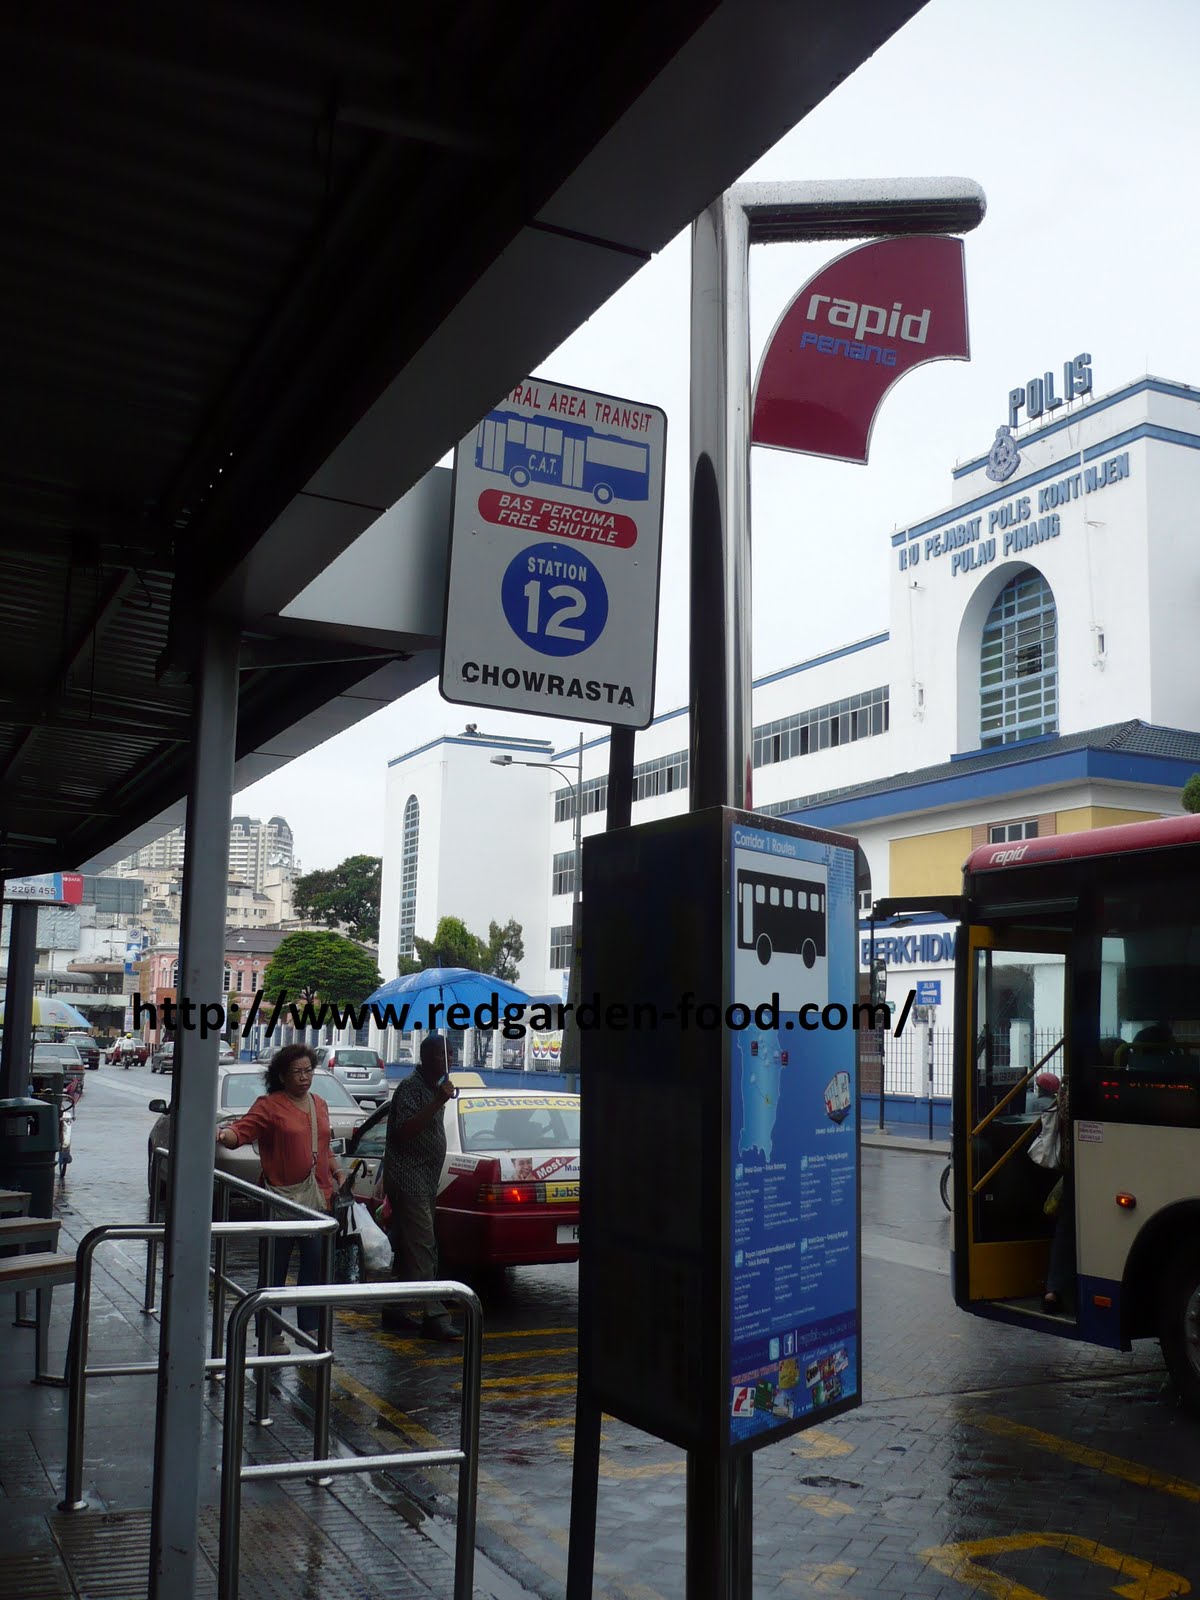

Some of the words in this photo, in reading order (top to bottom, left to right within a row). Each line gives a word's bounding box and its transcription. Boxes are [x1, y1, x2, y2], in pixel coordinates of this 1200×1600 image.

[806, 294, 931, 344] rapid
[1008, 352, 1093, 429] POLIS
[548, 392, 586, 418] AREA
[595, 402, 652, 432] TRANSIT
[528, 454, 557, 475] C.A.T.
[497, 510, 539, 529] FREE
[550, 519, 618, 544] SHUTTLE
[498, 495, 532, 512] BAS
[541, 502, 615, 529] PERCUMA
[925, 516, 982, 560] PEJABAT
[988, 496, 1031, 534] POLIS
[951, 538, 996, 577] PULAU
[1003, 513, 1060, 556] PINANG
[527, 556, 587, 582] STATION
[524, 579, 586, 642] 12
[461, 661, 635, 707] CHOWRASTA
[734, 830, 764, 849] Corridor
[772, 838, 796, 856] Routes
[989, 845, 1028, 865] rapid
